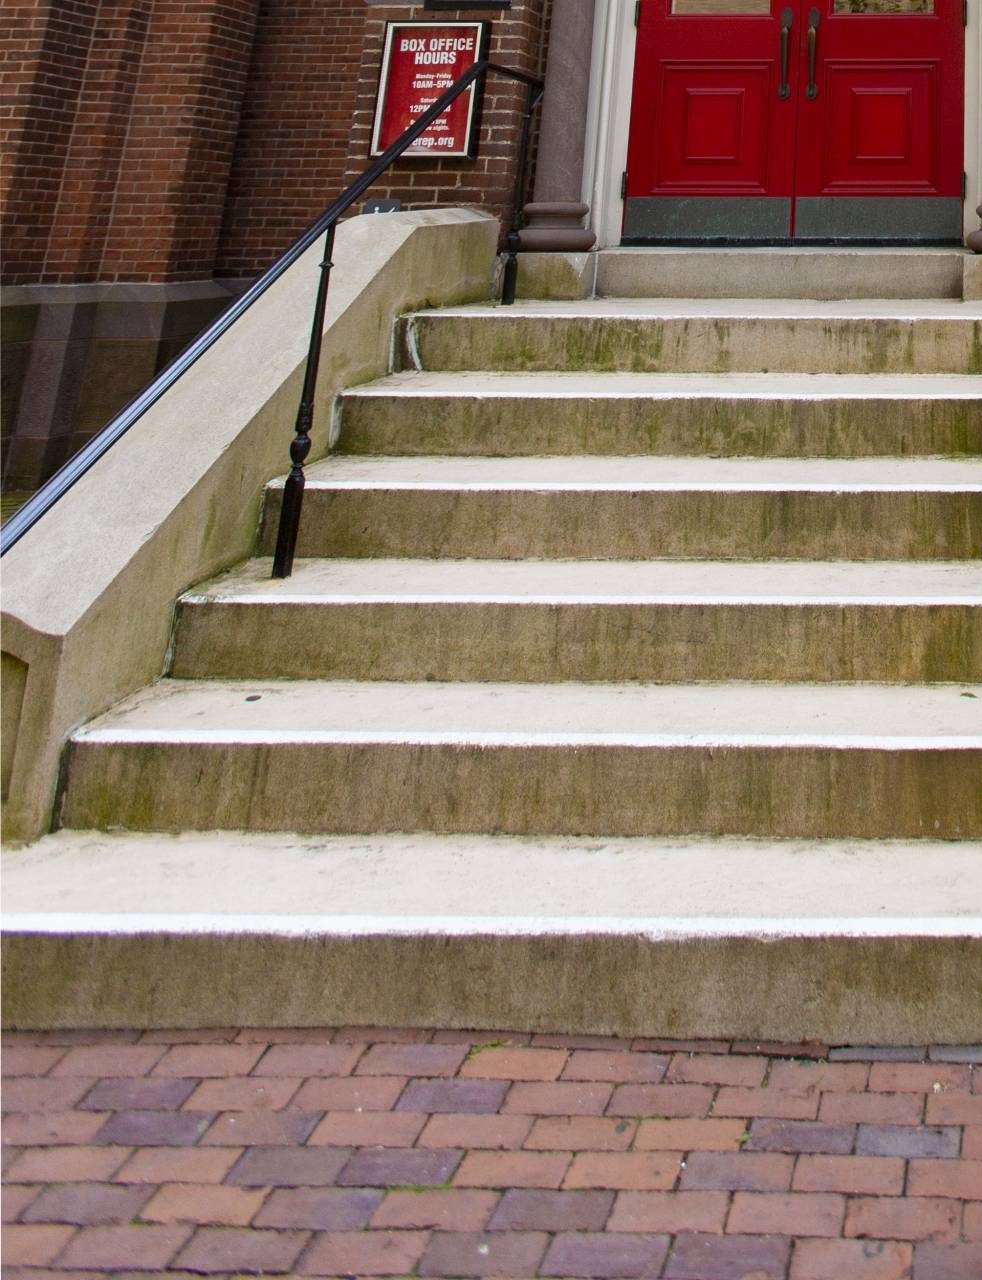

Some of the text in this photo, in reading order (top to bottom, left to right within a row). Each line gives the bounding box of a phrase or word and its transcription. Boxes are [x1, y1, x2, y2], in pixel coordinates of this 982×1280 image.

[400, 38, 474, 52] BOX OFFICE
[415, 51, 457, 64] HOURS
